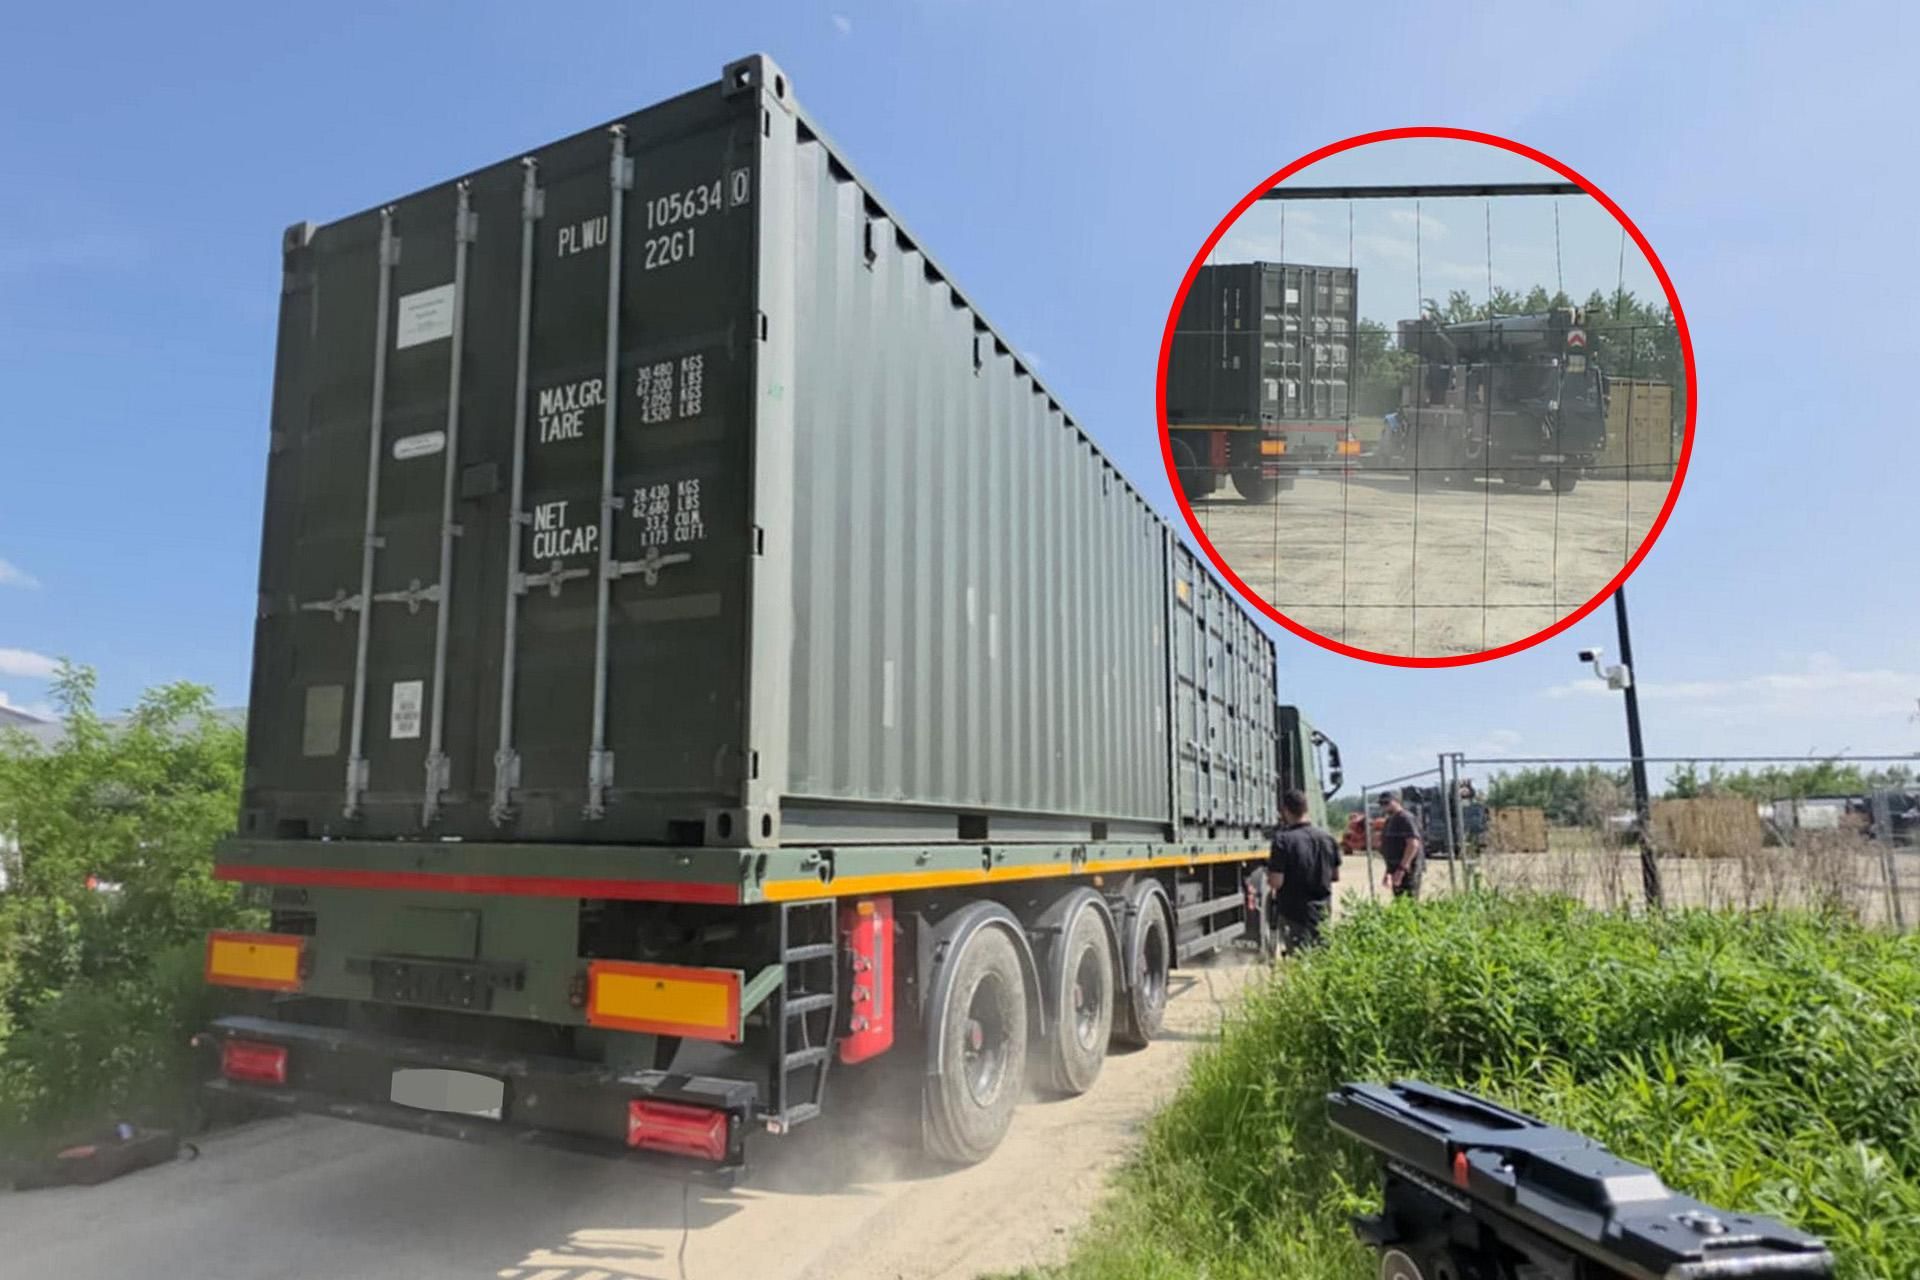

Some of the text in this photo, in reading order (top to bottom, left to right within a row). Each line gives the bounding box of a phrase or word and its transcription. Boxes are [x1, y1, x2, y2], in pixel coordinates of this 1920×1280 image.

[558, 216, 607, 257] PLWU
[647, 179, 721, 230] 105634
[645, 228, 695, 269] 22G1
[538, 410, 584, 444] TARE
[534, 501, 568, 531] NET
